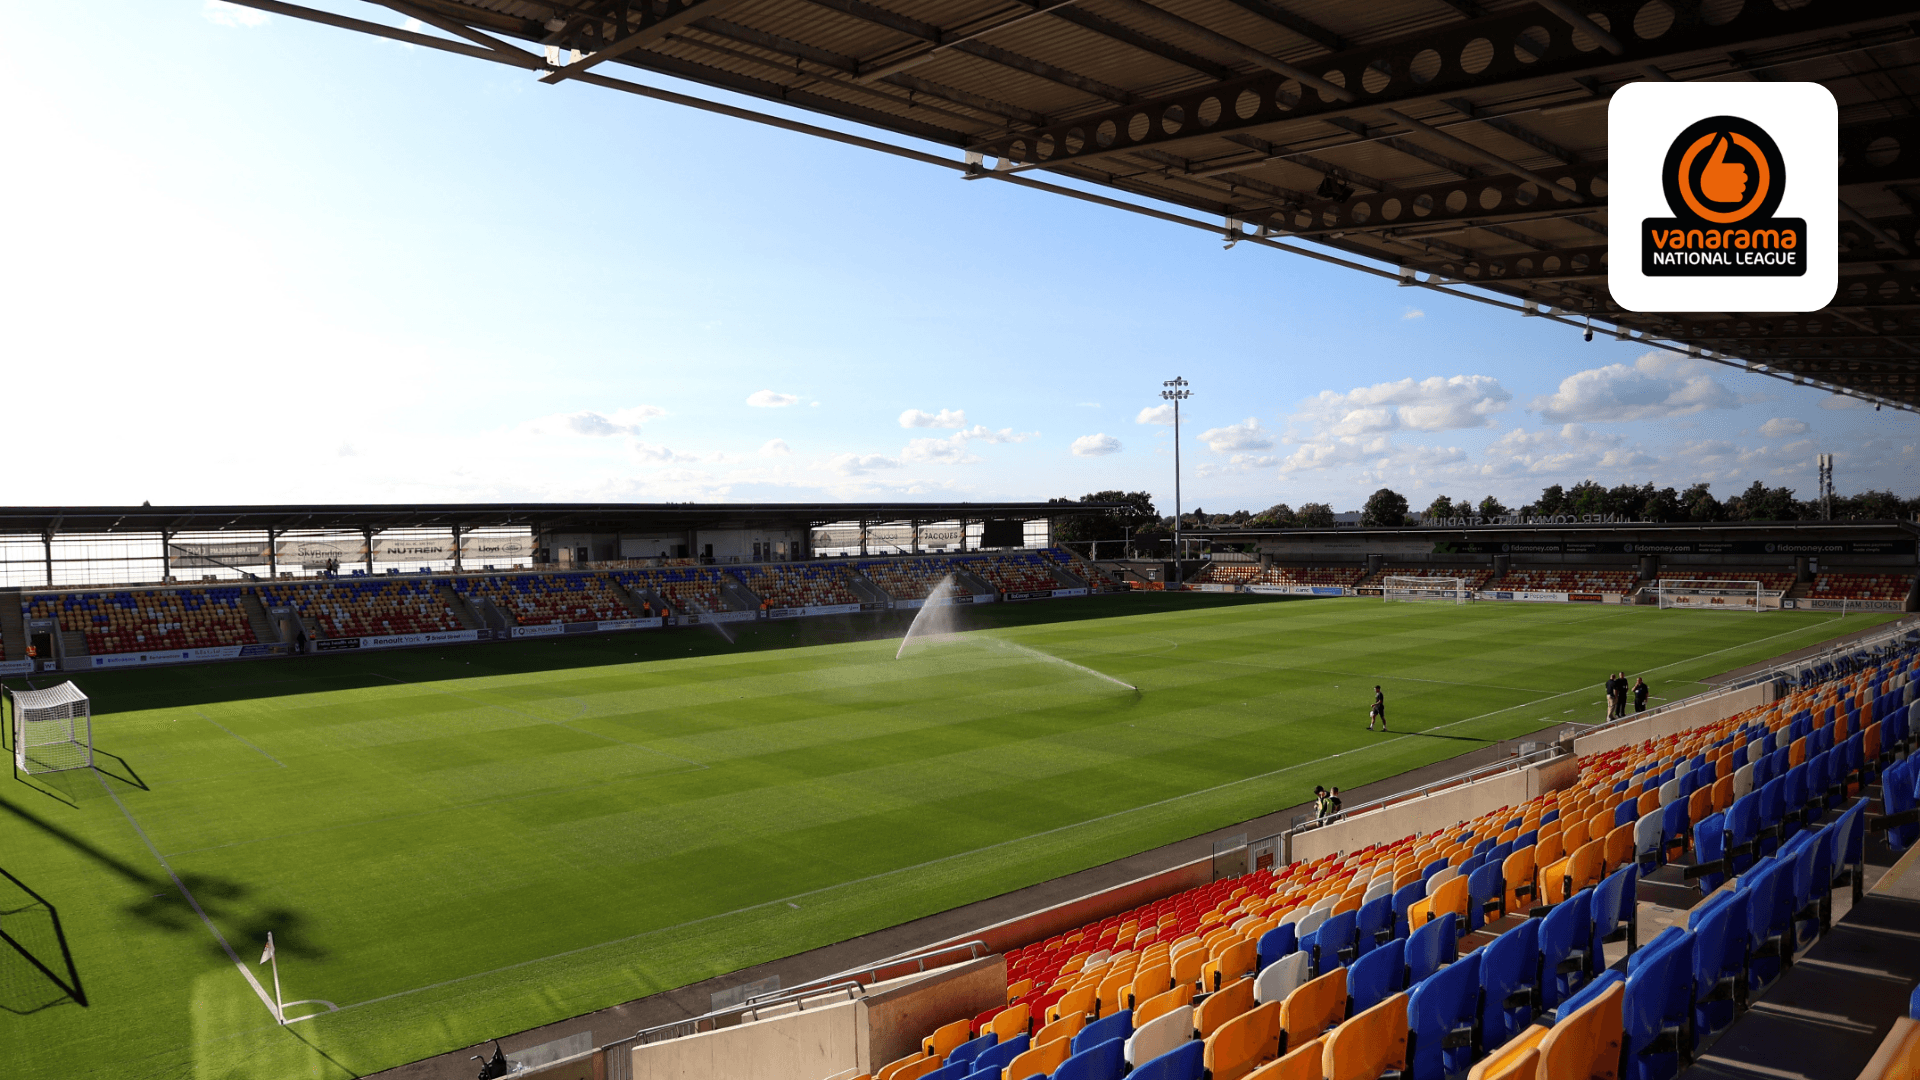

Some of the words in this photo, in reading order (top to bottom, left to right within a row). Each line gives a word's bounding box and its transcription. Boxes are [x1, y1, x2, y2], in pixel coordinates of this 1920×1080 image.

[924, 532, 958, 540] JACQUES
[387, 546, 442, 555] NUTREIN
[1510, 544, 1560, 553] fidomoney.com
[1634, 544, 1691, 553] fidomoney.com
[1777, 544, 1843, 553] fidomoney.com
[1865, 601, 1899, 610] STORES
[373, 635, 404, 645] Renault
[404, 635, 421, 643] York
